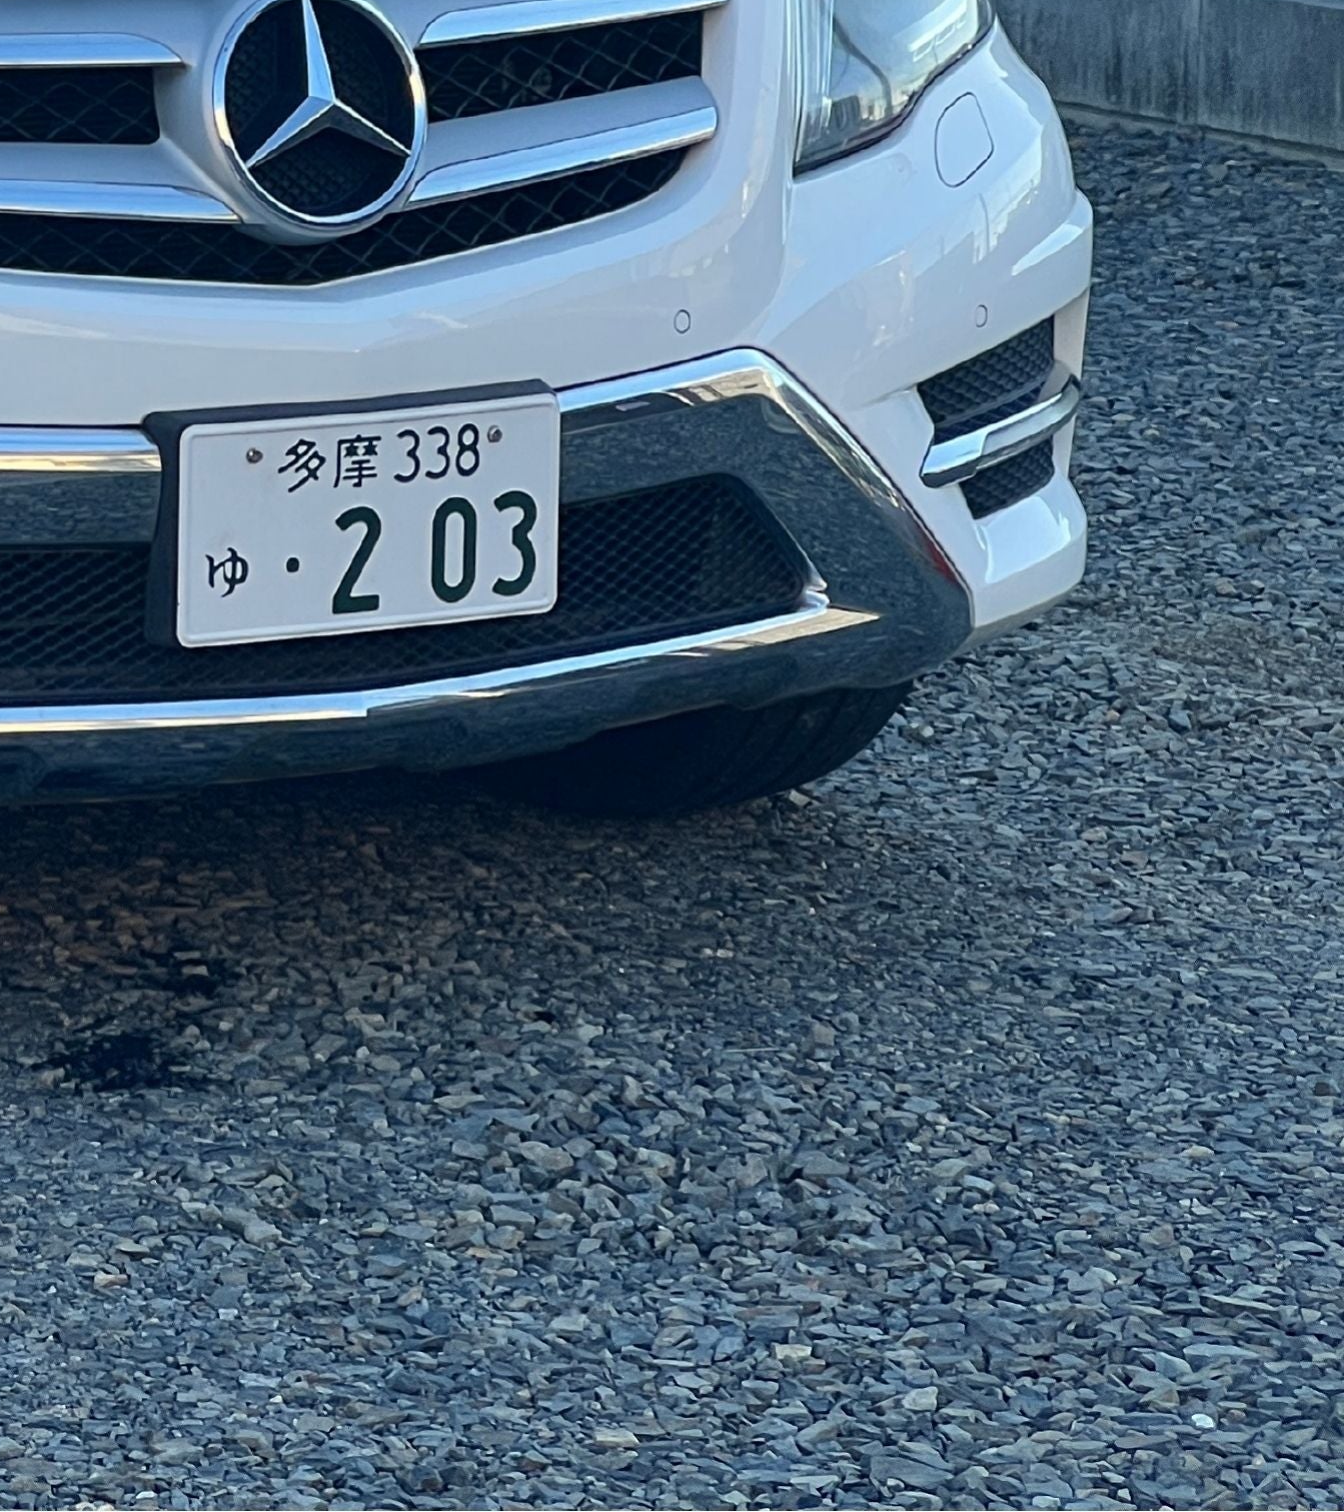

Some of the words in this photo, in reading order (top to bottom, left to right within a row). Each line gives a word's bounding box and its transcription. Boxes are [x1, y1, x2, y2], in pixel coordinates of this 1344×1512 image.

[277, 434, 382, 492] 多摩
[393, 423, 480, 484] 338
[205, 547, 250, 598] ゆ
